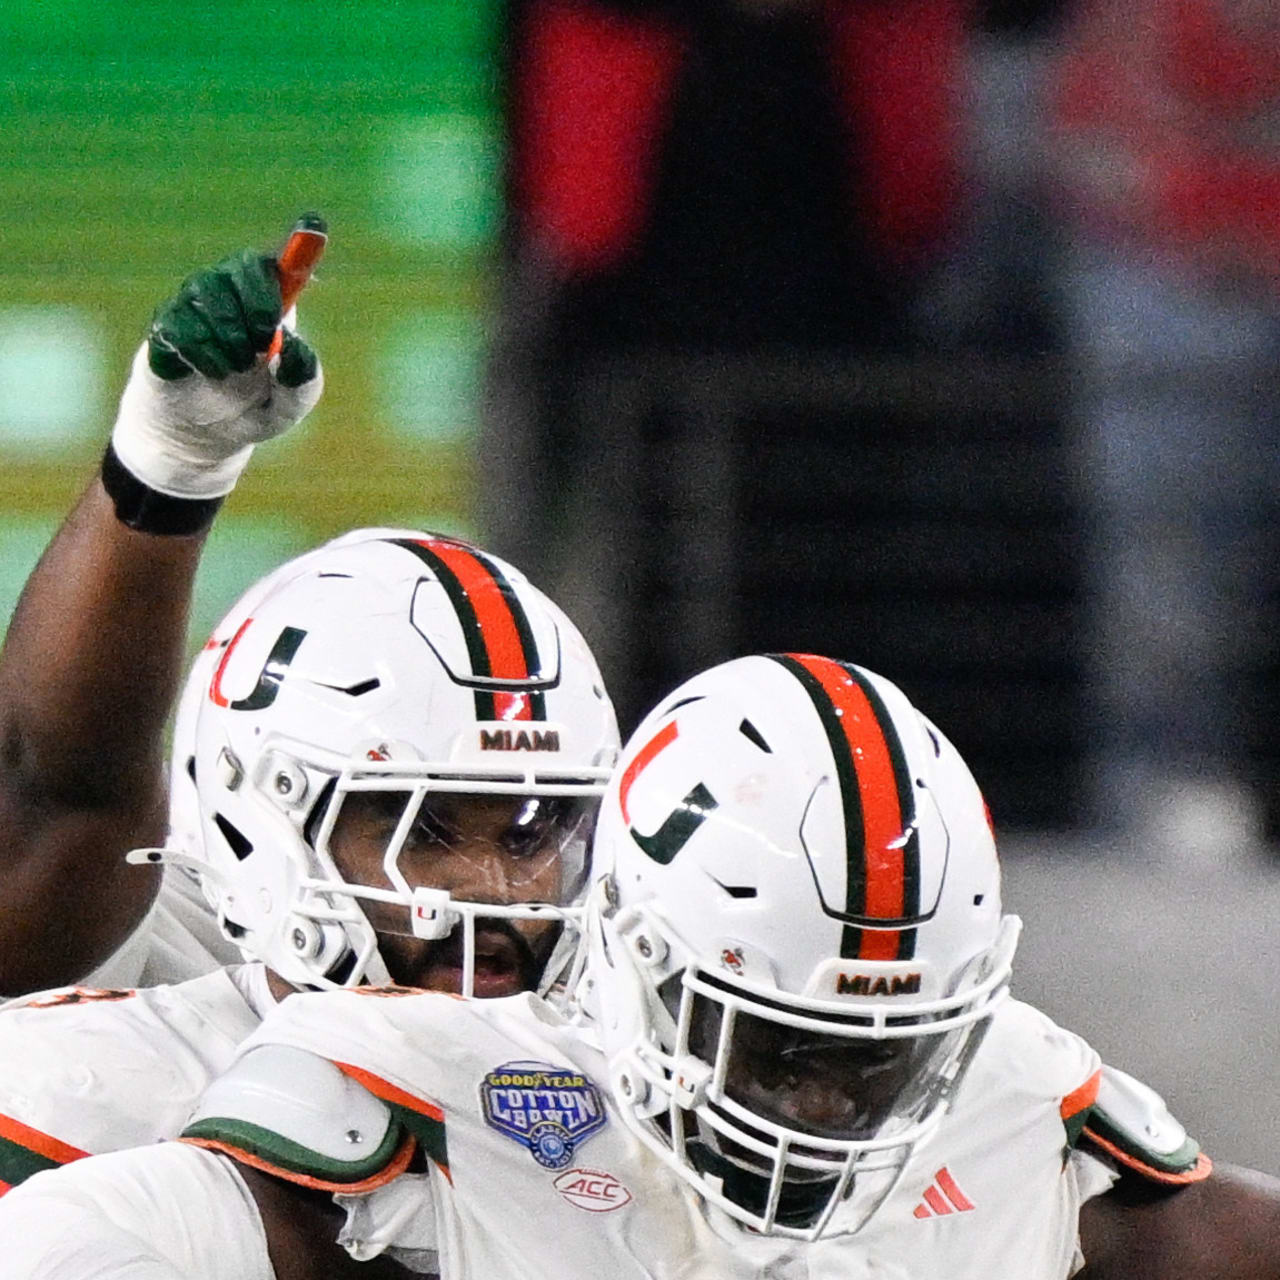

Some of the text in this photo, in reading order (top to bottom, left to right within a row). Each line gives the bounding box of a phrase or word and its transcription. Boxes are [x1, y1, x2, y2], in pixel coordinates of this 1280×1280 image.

[209, 617, 308, 711] U
[480, 730, 560, 752] MIAMI
[619, 719, 720, 866] U
[836, 972, 921, 996] MIAMI
[489, 1073, 585, 1087] GOODYEAR
[490, 1089, 597, 1122] COTTON
[512, 1108, 580, 1129] BOWL
[563, 1178, 620, 1198] ACC
